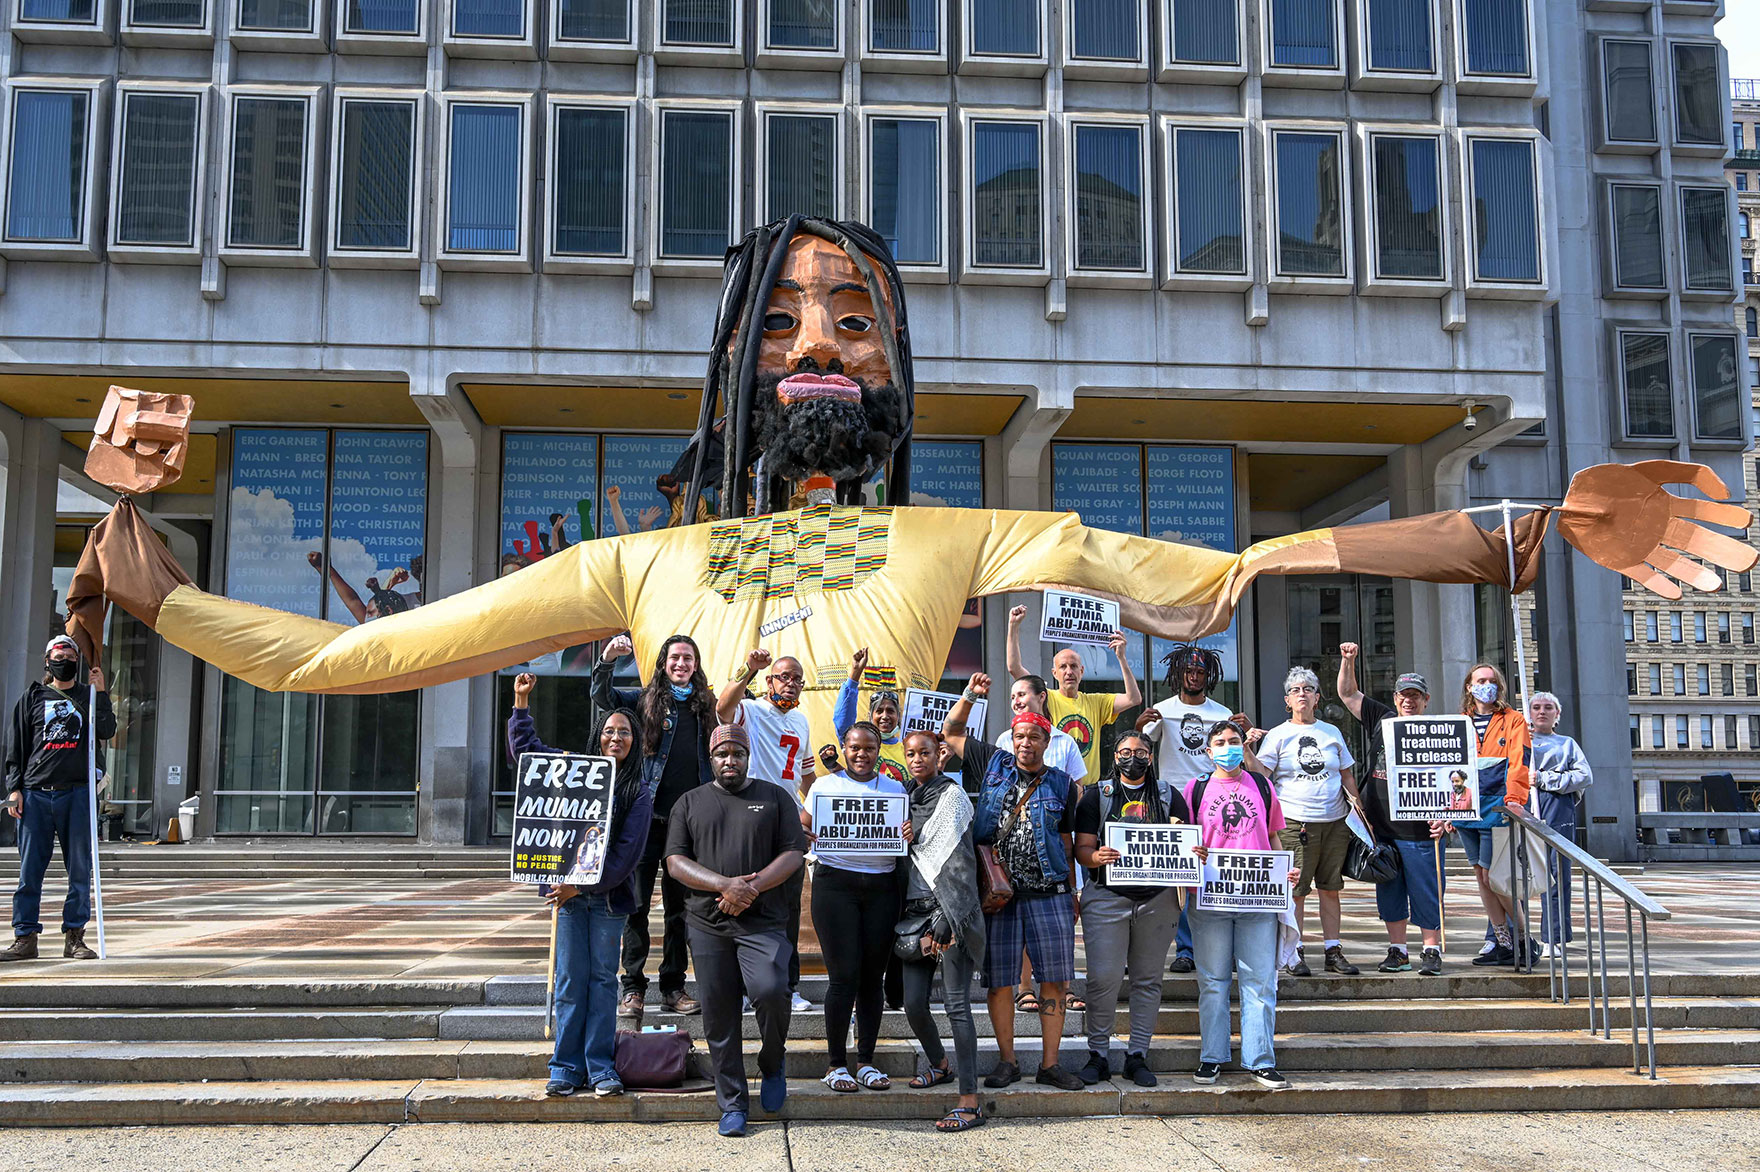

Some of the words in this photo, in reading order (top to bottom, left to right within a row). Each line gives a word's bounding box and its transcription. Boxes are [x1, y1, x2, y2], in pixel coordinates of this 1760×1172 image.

[242, 436, 266, 445] ERIC
[269, 436, 318, 446] GARNER
[336, 438, 370, 447] JOHN
[544, 442, 594, 452] MICHAEL
[605, 443, 650, 452] BROWN
[240, 452, 280, 461] MANN
[368, 454, 412, 464] TAYLOR
[504, 457, 566, 467] PHILANDO
[1178, 454, 1224, 463] GEORGE
[240, 469, 296, 478] NATASHA
[384, 471, 416, 480] TONY
[1072, 468, 1118, 476] AJIBADE
[1190, 470, 1224, 478] FLOYD
[922, 480, 946, 490] ERIC
[950, 481, 980, 490] HARR
[1076, 484, 1118, 492] WALTER
[1176, 485, 1224, 494] WILLIAM
[333, 487, 404, 497] QUINTONIO
[382, 504, 424, 513] SANDR
[514, 506, 554, 515] BLAND
[1094, 500, 1124, 508] GRAY
[1188, 501, 1224, 510] MANN
[358, 520, 420, 530] CHRISTIAN
[1188, 516, 1225, 526] SABBIE
[363, 536, 424, 546] PATERSON
[236, 551, 265, 560] PAUL
[394, 552, 412, 562] LEE
[234, 568, 284, 577] ESPINAL
[1060, 596, 1104, 612] FREE
[760, 605, 812, 636] INNOCENT
[1061, 608, 1103, 622] MUMIA
[1047, 617, 1114, 634] ABU-JAMAL
[1405, 723, 1426, 734] The
[1430, 723, 1455, 735] only
[1401, 736, 1462, 748] treatment
[780, 735, 800, 780] 7
[1402, 751, 1414, 762] is
[1416, 751, 1462, 762] release
[524, 758, 608, 790] FREE
[1398, 772, 1437, 788] FREE
[832, 798, 889, 812] FREE
[1208, 794, 1226, 816] FREE
[1229, 792, 1258, 818] MUMIA
[1398, 792, 1450, 808] MUMIA!
[518, 796, 602, 820] MUMIA
[834, 812, 886, 826] MUMIA
[516, 828, 576, 848] NOW!
[819, 826, 900, 838] ABU-JAMAL
[1124, 830, 1182, 842] FREE
[878, 842, 901, 850] PROGRESS
[1128, 844, 1180, 856] MUMIA
[1113, 856, 1196, 869] ABU-JAMAL
[1218, 855, 1274, 868] FREE
[1165, 872, 1173, 880] FOR
[1174, 872, 1198, 880] PROGRESS
[1220, 868, 1270, 882] MUMIA
[1204, 880, 1284, 896] ABU-JAMAL
[1202, 896, 1222, 904] PEOPLE'S
[1223, 897, 1254, 906] ORGANIZATION
